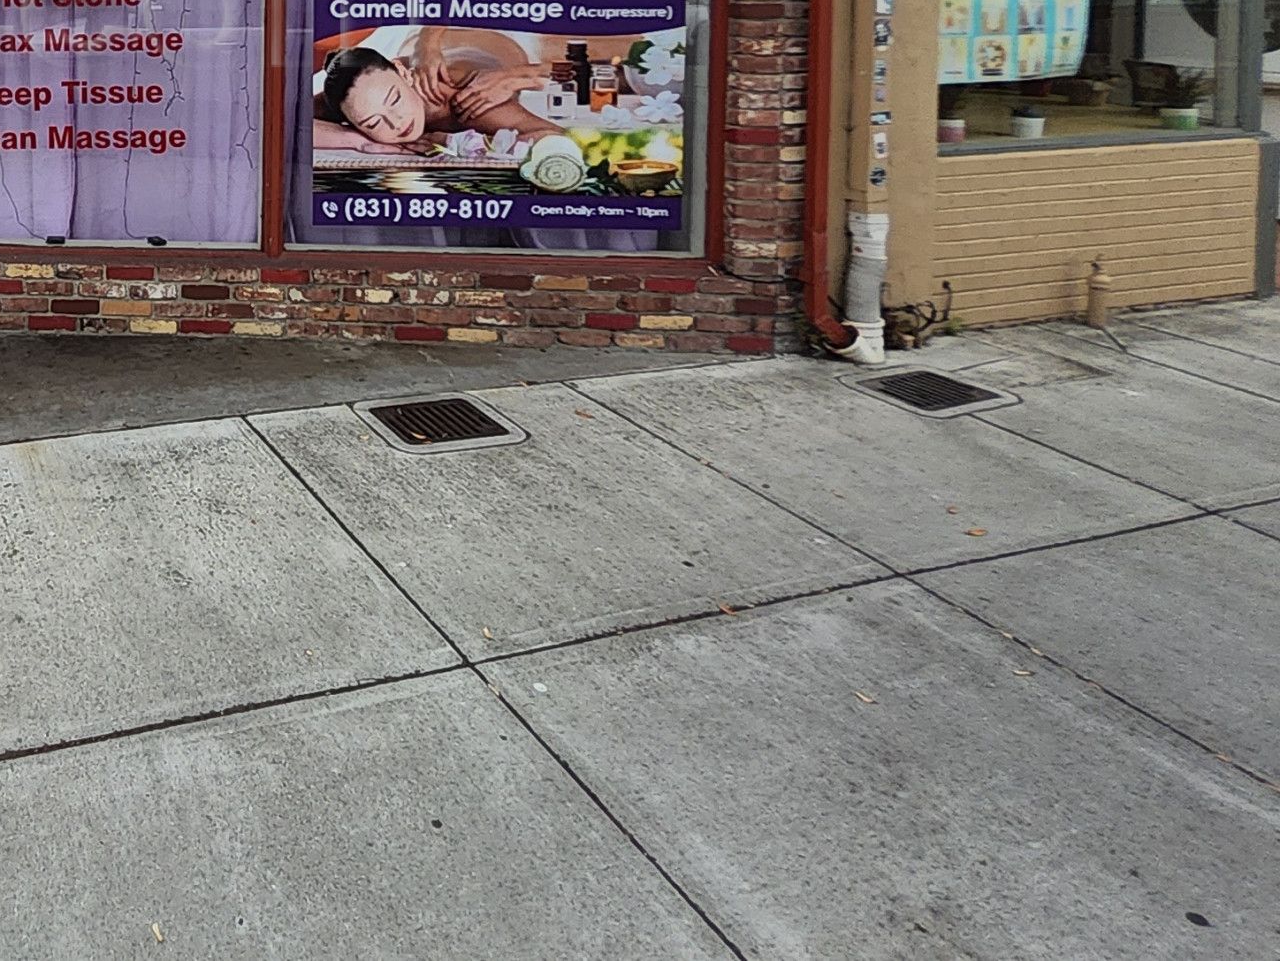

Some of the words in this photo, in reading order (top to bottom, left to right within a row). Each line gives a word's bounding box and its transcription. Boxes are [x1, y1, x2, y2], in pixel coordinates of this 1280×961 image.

[449, 0, 564, 24] Massage
[570, 5, 674, 20] (Acupressure)
[44, 29, 184, 56] Massage
[61, 81, 163, 105] Tissue
[48, 127, 186, 153] Massage
[344, 198, 402, 222] (831)
[408, 198, 514, 219] 889-8107
[530, 205, 563, 216] Open
[565, 206, 596, 217] Daily:
[597, 206, 624, 215] 9am
[636, 207, 669, 217] 10pm
